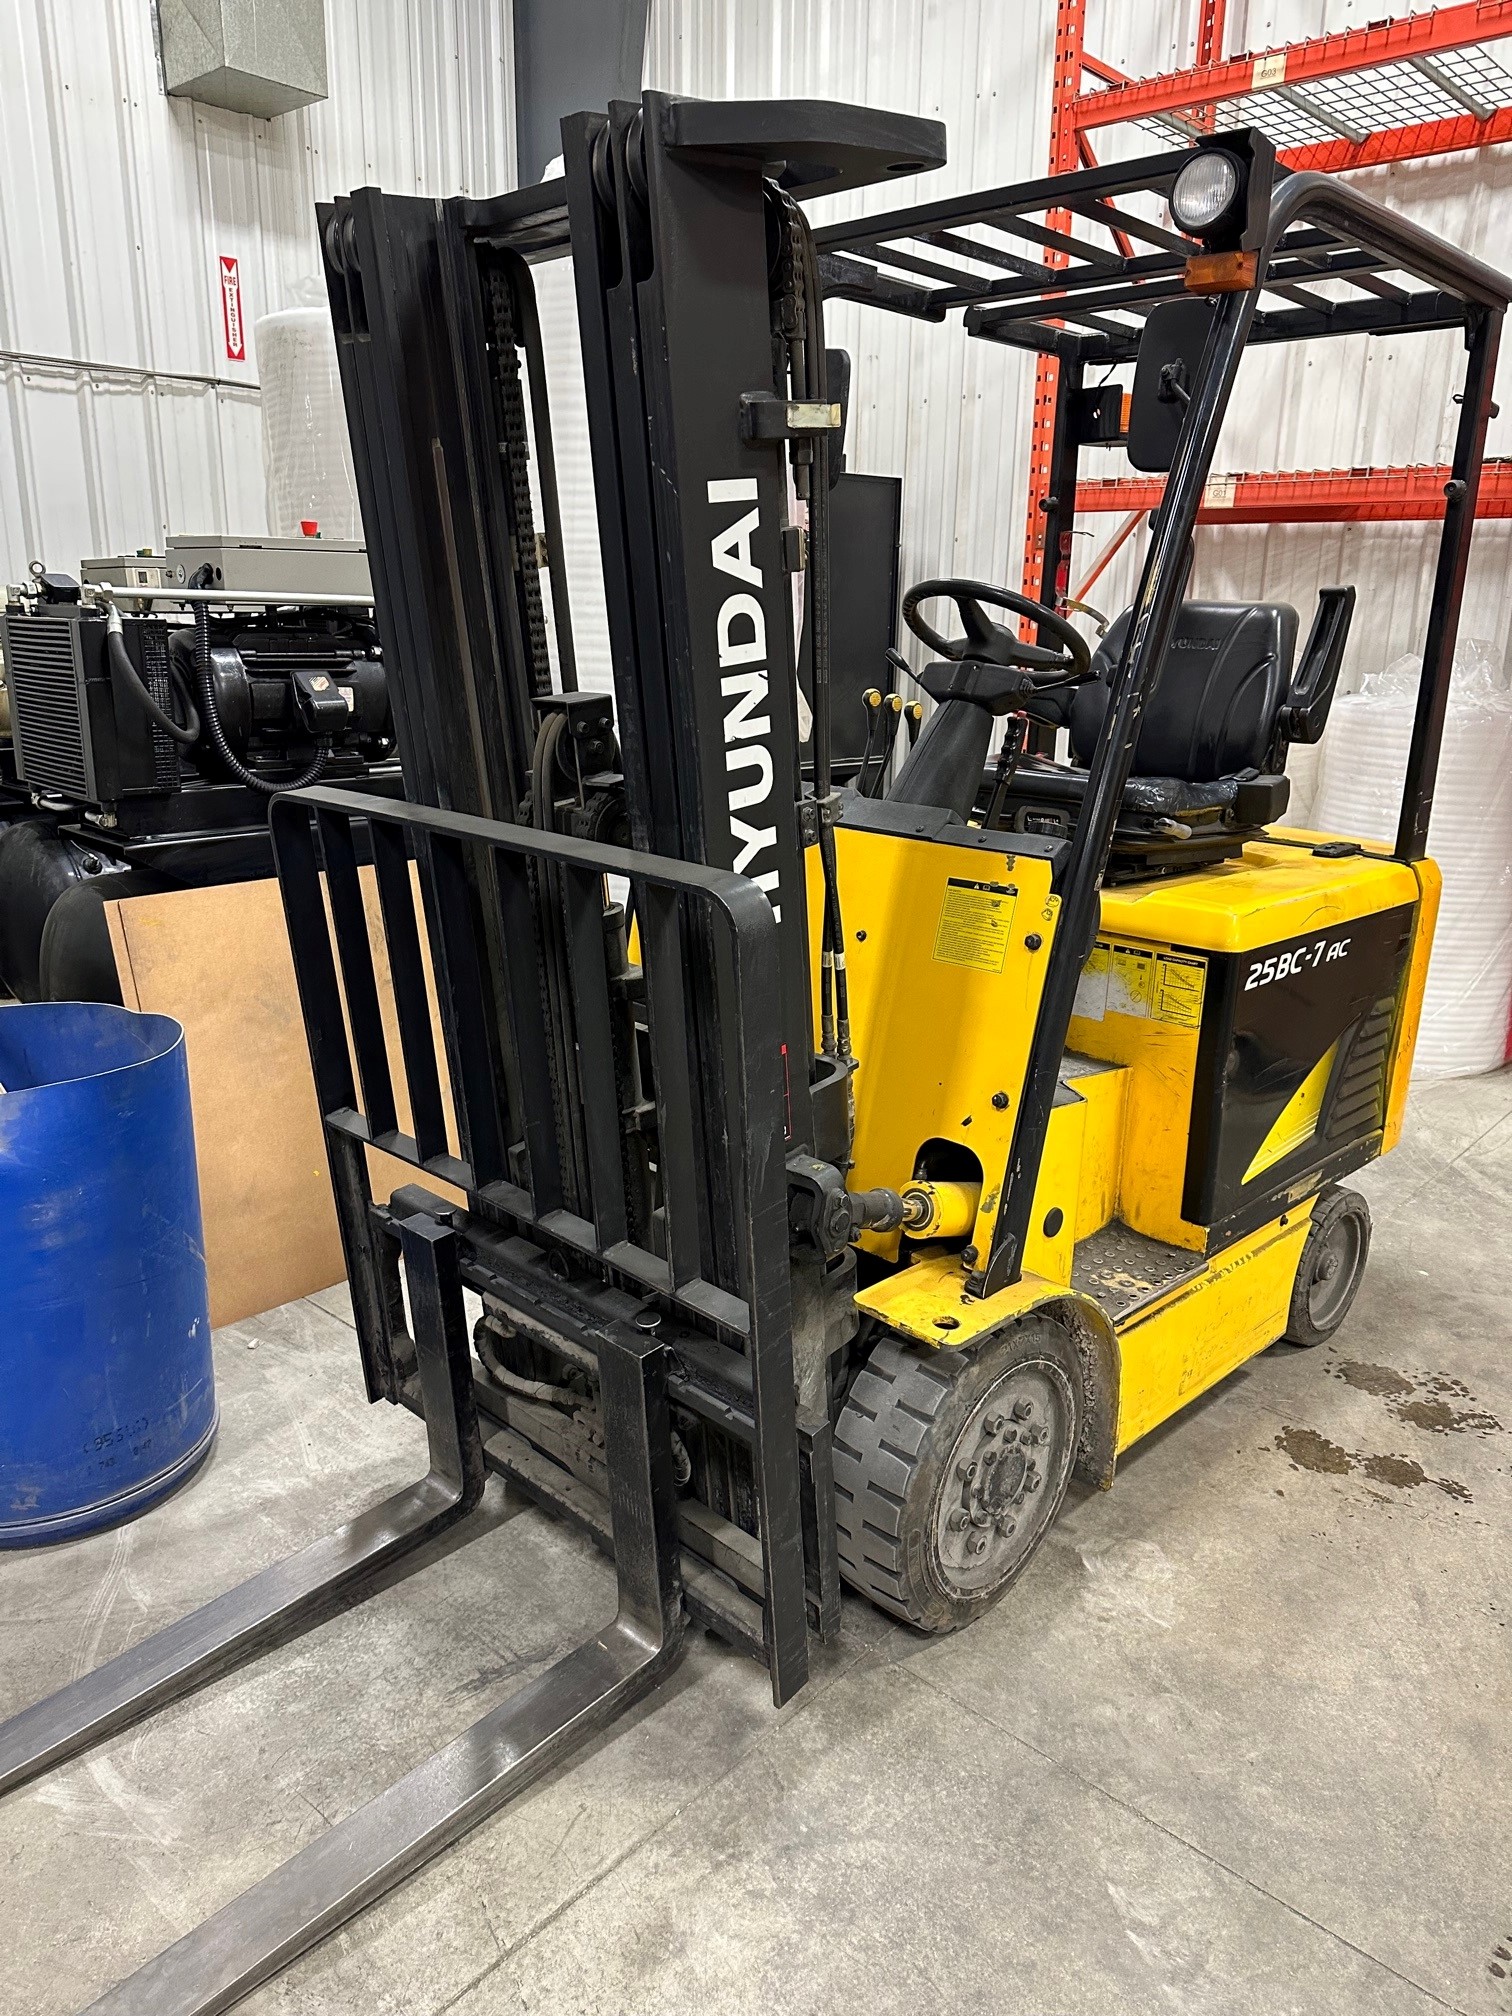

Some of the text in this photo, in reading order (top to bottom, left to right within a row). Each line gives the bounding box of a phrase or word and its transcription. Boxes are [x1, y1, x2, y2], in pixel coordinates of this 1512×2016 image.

[1260, 67, 1277, 78] G03
[224, 275, 237, 286] FIRE
[228, 287, 239, 348] EXTINGUISHER
[1244, 938, 1352, 992] 25BC-7 AC
